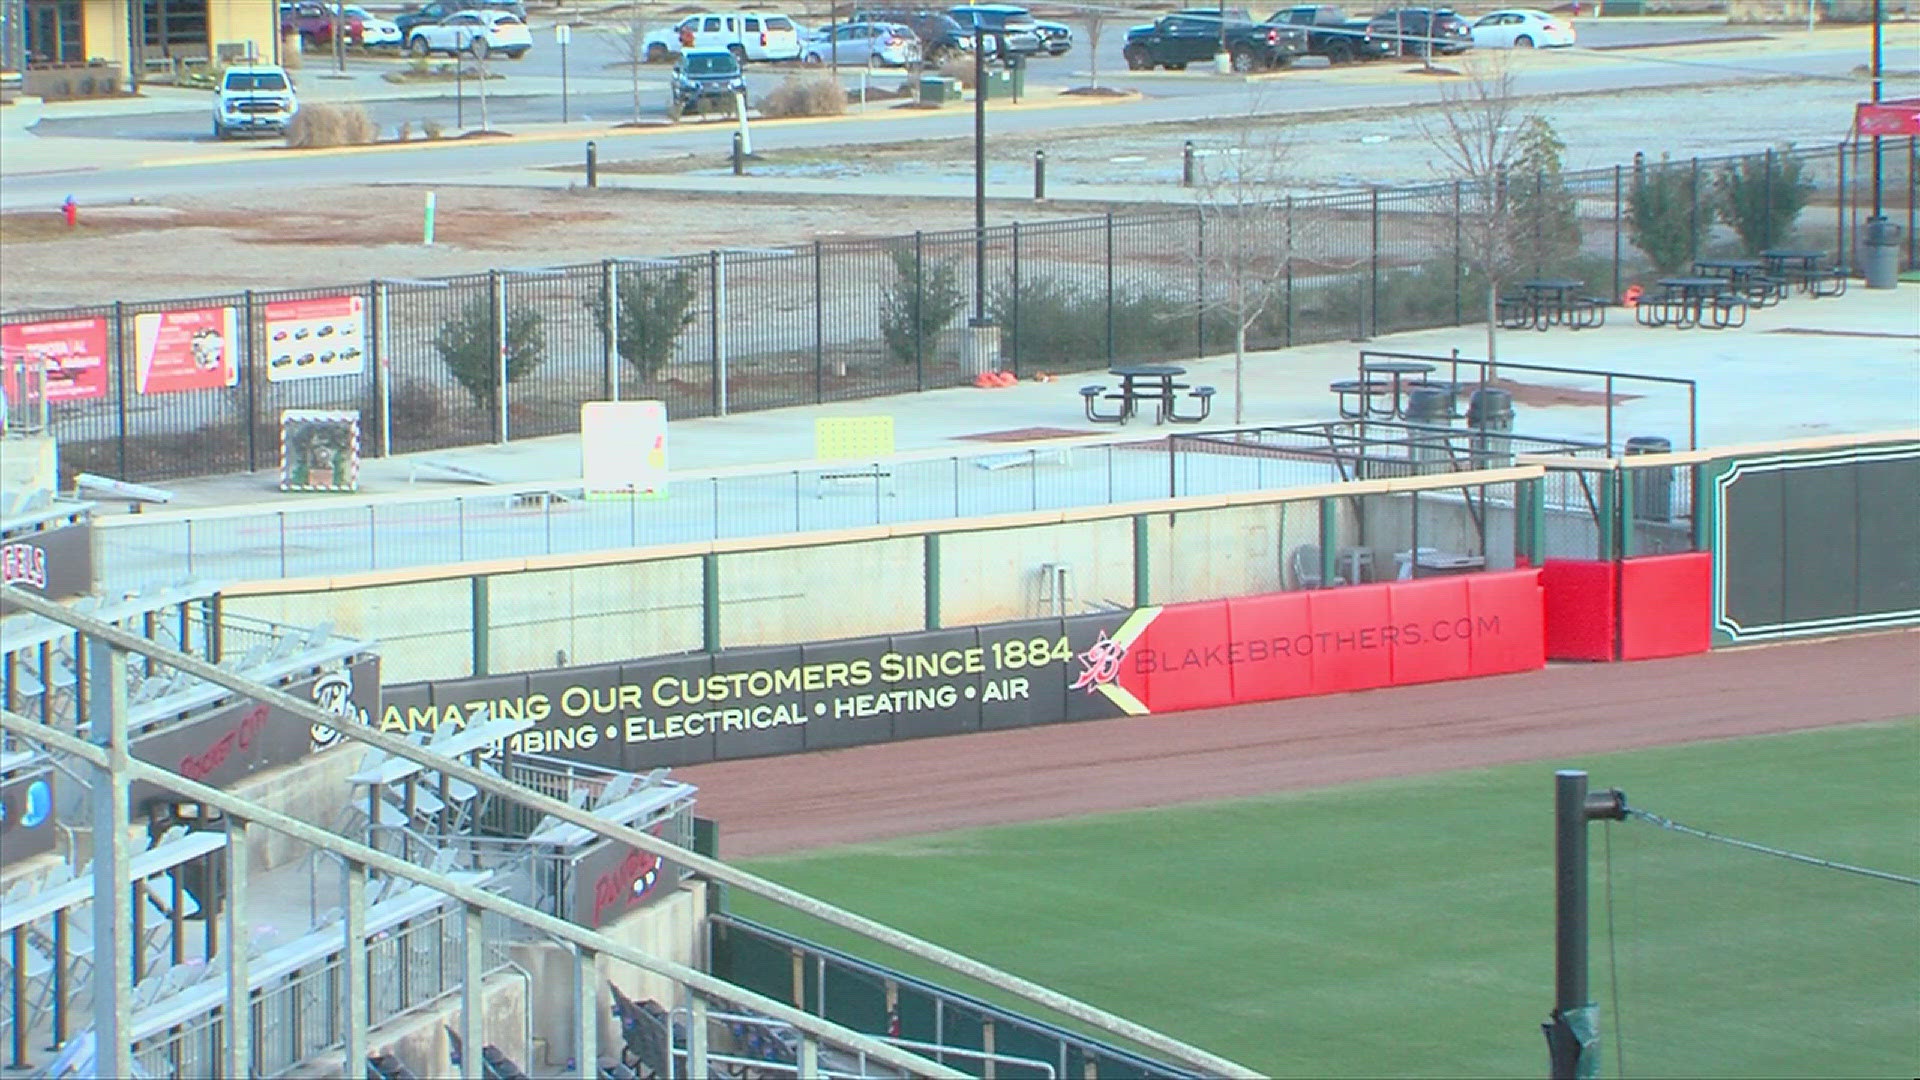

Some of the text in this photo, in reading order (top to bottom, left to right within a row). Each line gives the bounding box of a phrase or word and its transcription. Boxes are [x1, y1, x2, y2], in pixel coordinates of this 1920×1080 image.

[561, 684, 642, 717] OUR
[652, 661, 872, 708] CUSTOMERS
[880, 648, 985, 683] SINCE
[991, 636, 1074, 669] 1884
[1135, 615, 1501, 675] BLAKEBROTHERS.COM
[625, 703, 808, 743] ELECTRICAL
[834, 685, 957, 719] HEATING
[982, 678, 1030, 703] AIR
